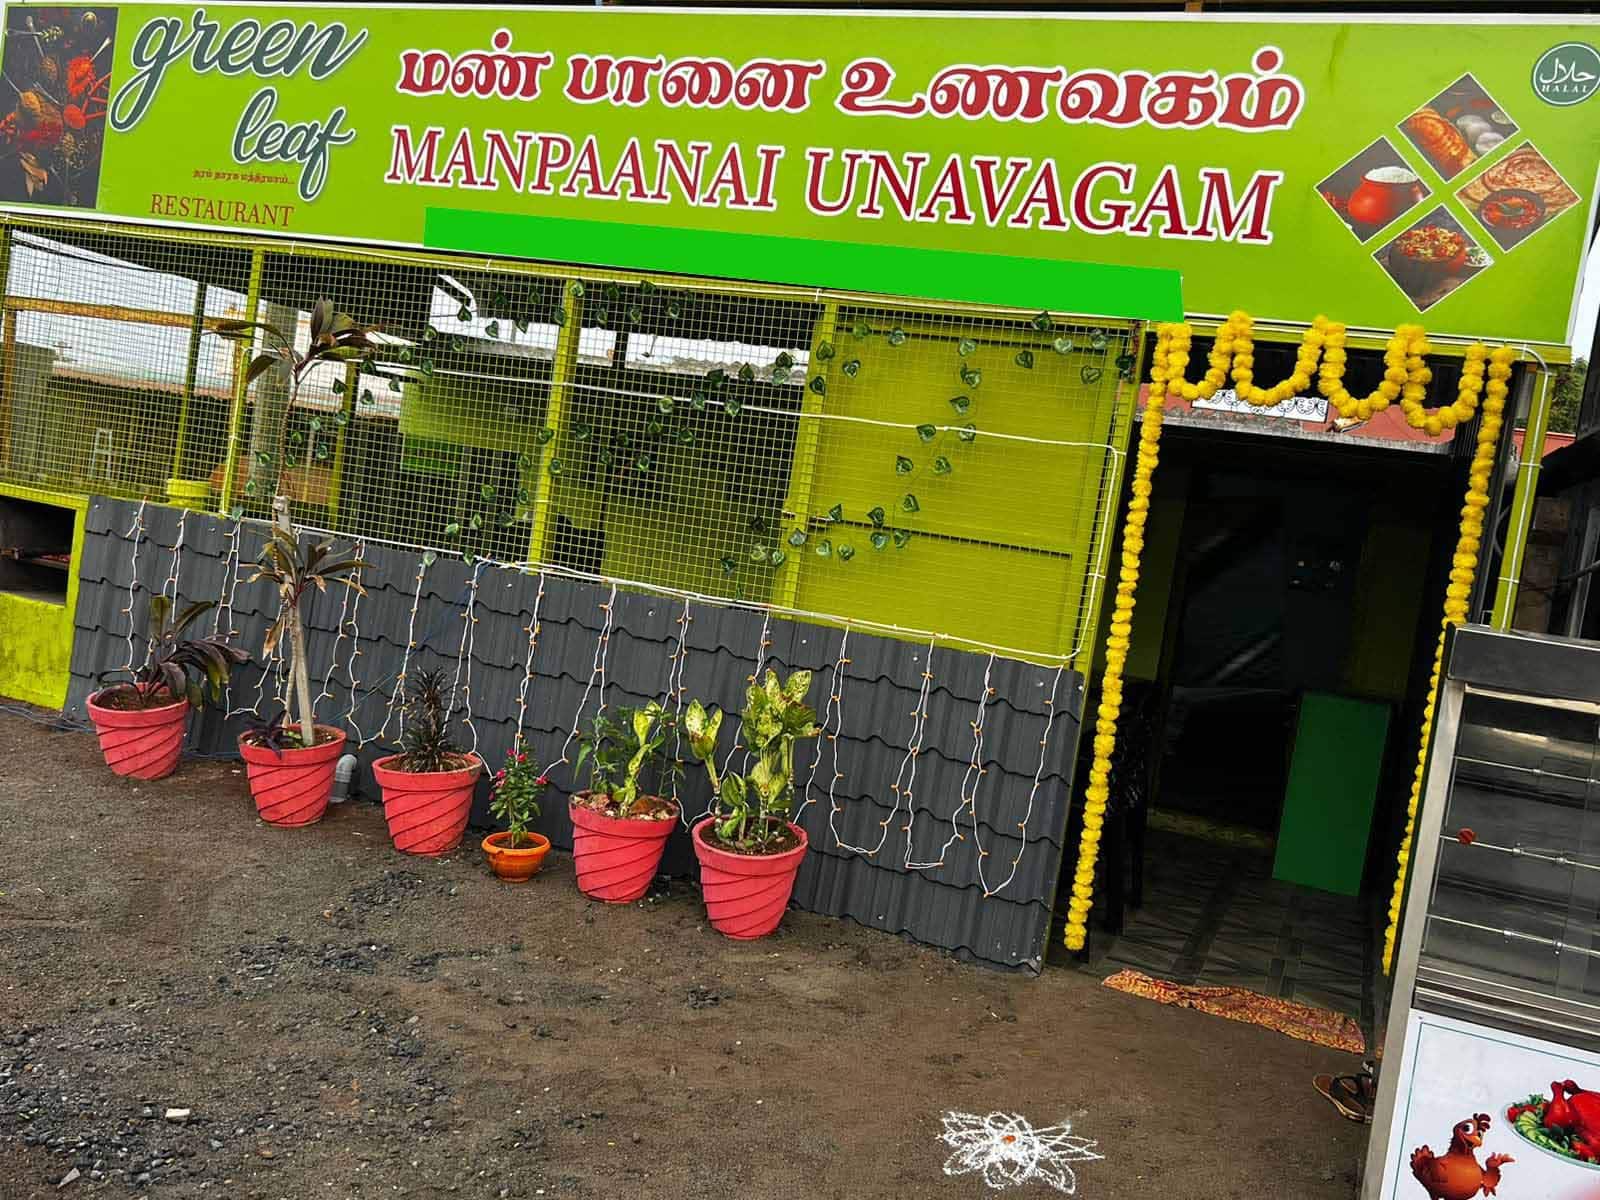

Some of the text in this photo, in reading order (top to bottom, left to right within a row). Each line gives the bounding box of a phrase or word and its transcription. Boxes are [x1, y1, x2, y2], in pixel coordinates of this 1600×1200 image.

[111, 9, 367, 131] green
[397, 29, 1304, 130] மண் பானை உணவகம்
[1539, 57, 1596, 84] حلال
[1541, 84, 1588, 93] HALAL
[232, 88, 355, 201] leaf
[386, 126, 1283, 244] MANPAANAI UNAVAGAM
[151, 194, 294, 227] RESTAURANT
